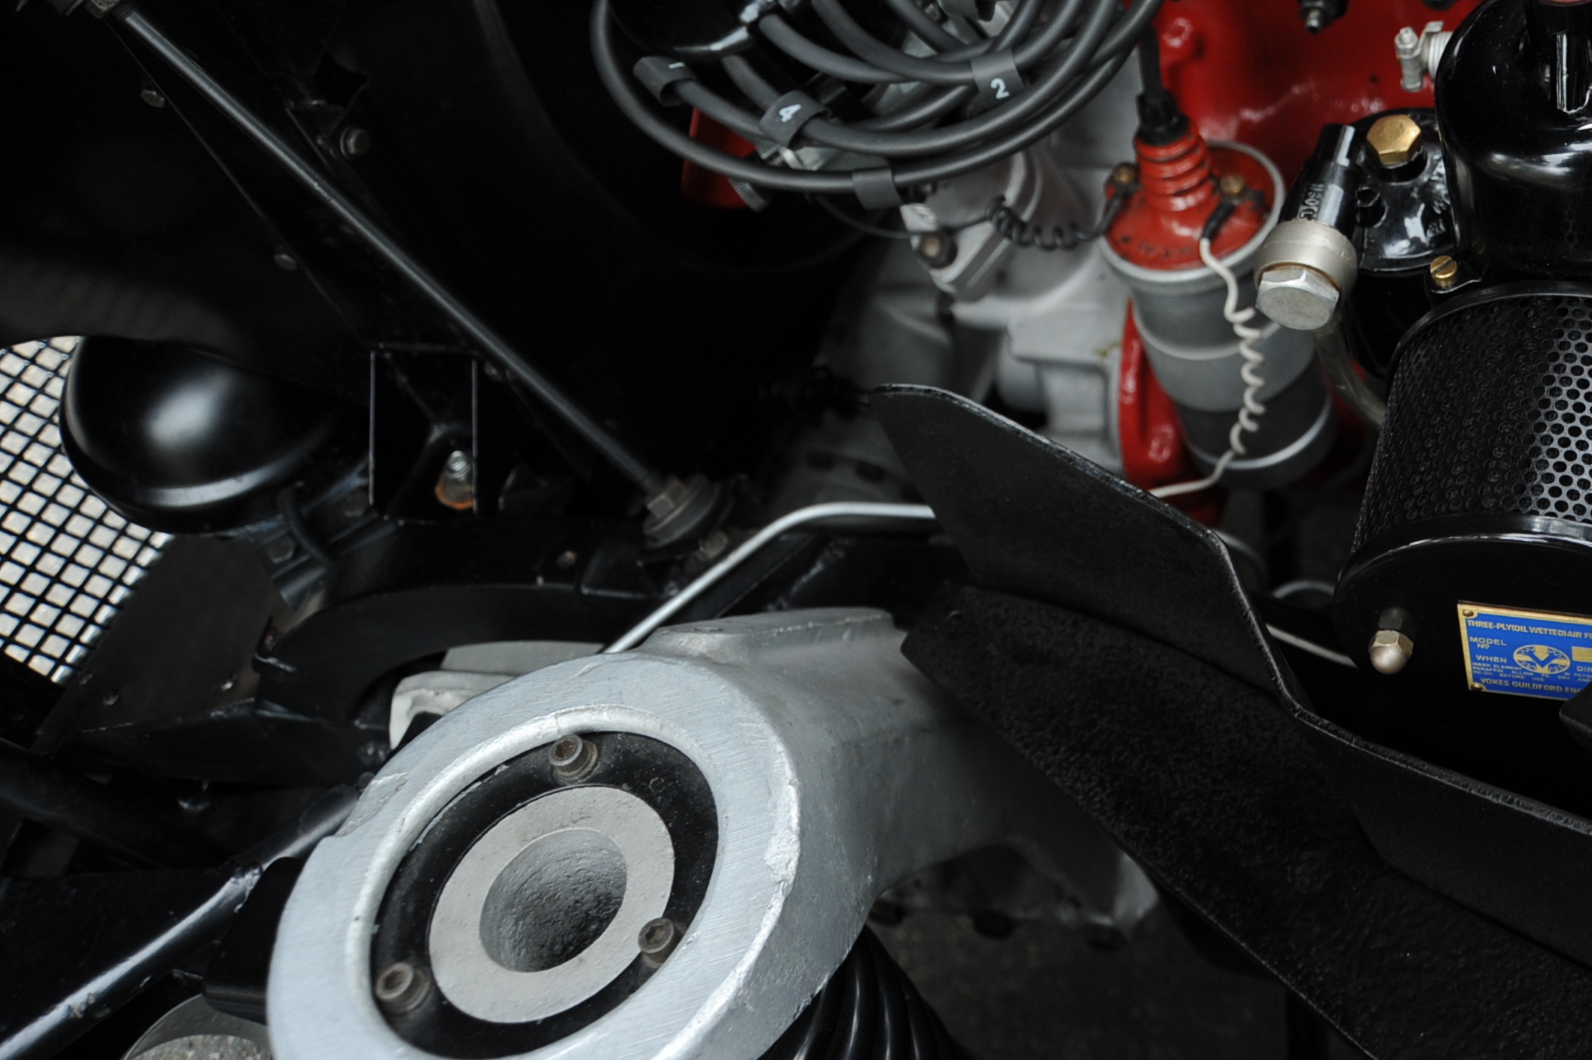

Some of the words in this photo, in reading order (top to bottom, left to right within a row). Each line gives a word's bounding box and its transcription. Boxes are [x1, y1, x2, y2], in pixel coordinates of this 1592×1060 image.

[989, 76, 1010, 100] 2
[777, 103, 802, 123] 4
[1469, 636, 1507, 646] MODEL
[1475, 654, 1508, 663] WHEN
[1480, 677, 1510, 687] VOKES
[1511, 681, 1563, 692] GUILDFORD
